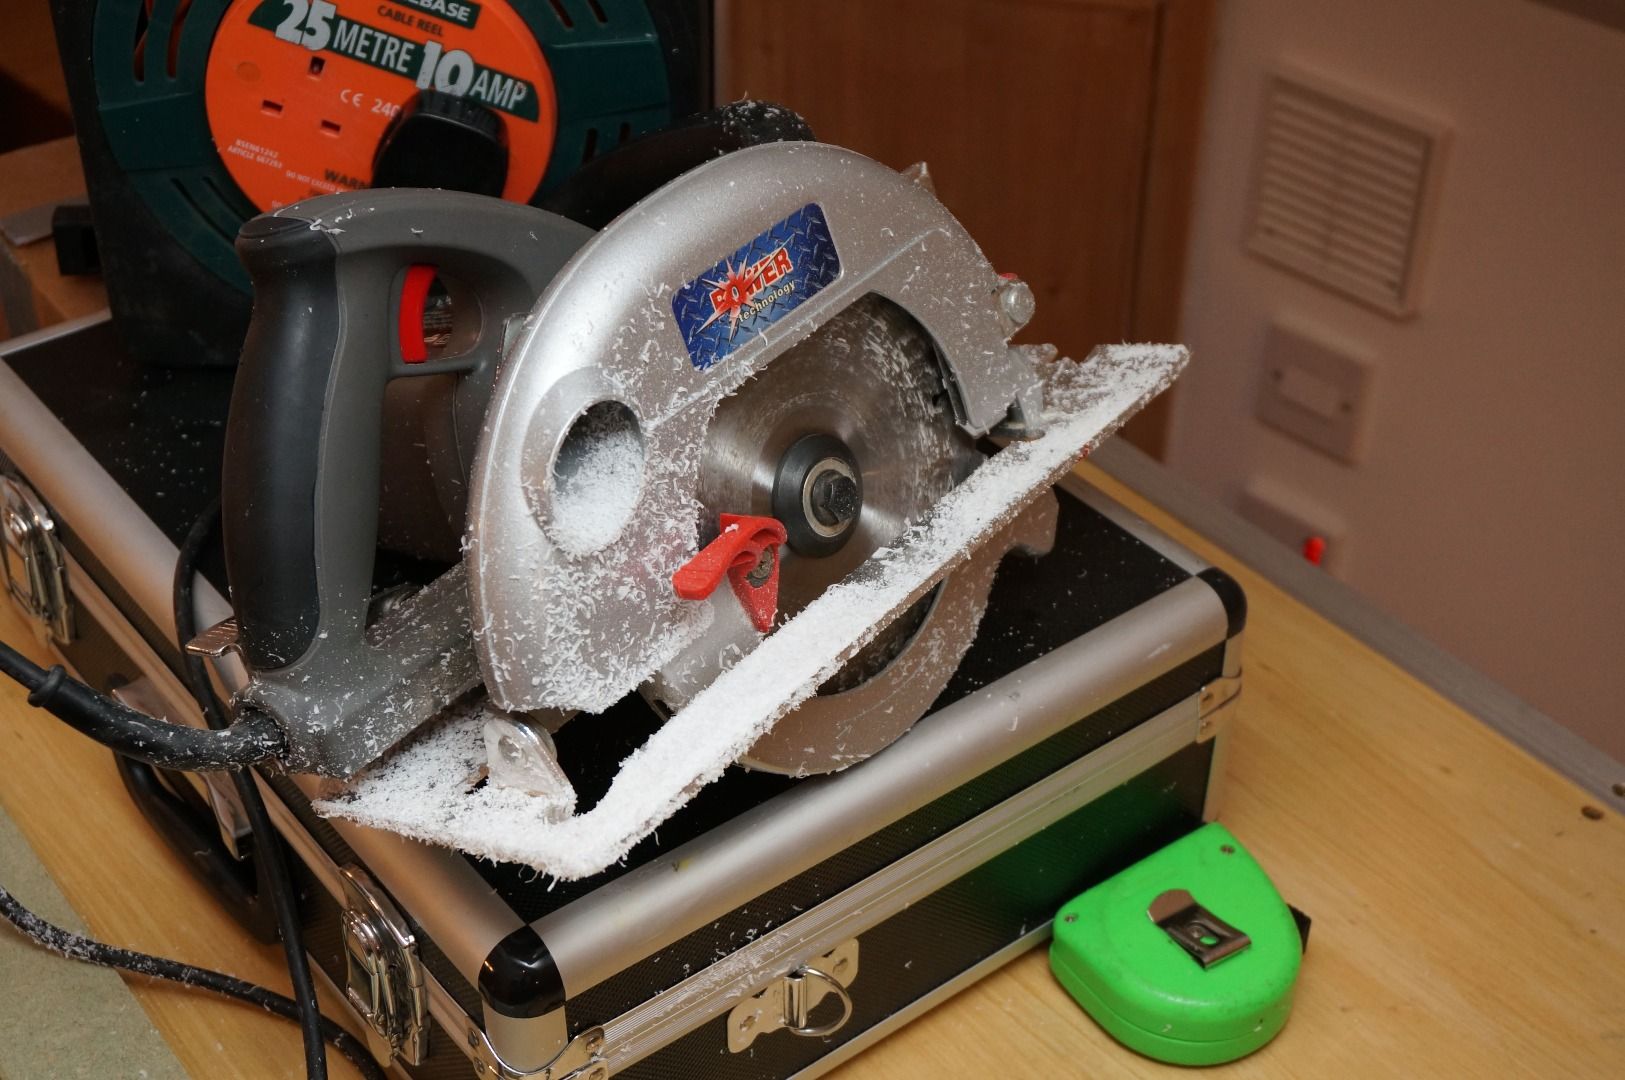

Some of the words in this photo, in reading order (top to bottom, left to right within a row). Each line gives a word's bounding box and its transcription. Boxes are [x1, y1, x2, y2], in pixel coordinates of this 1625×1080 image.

[378, 5, 414, 27] CABLE
[416, 18, 443, 37] REEL
[275, 0, 336, 51] 25
[333, 21, 416, 73] METRE
[415, 39, 475, 97] 10
[470, 70, 527, 110] AMP
[709, 247, 793, 312] POWER
[738, 279, 796, 323] technology
